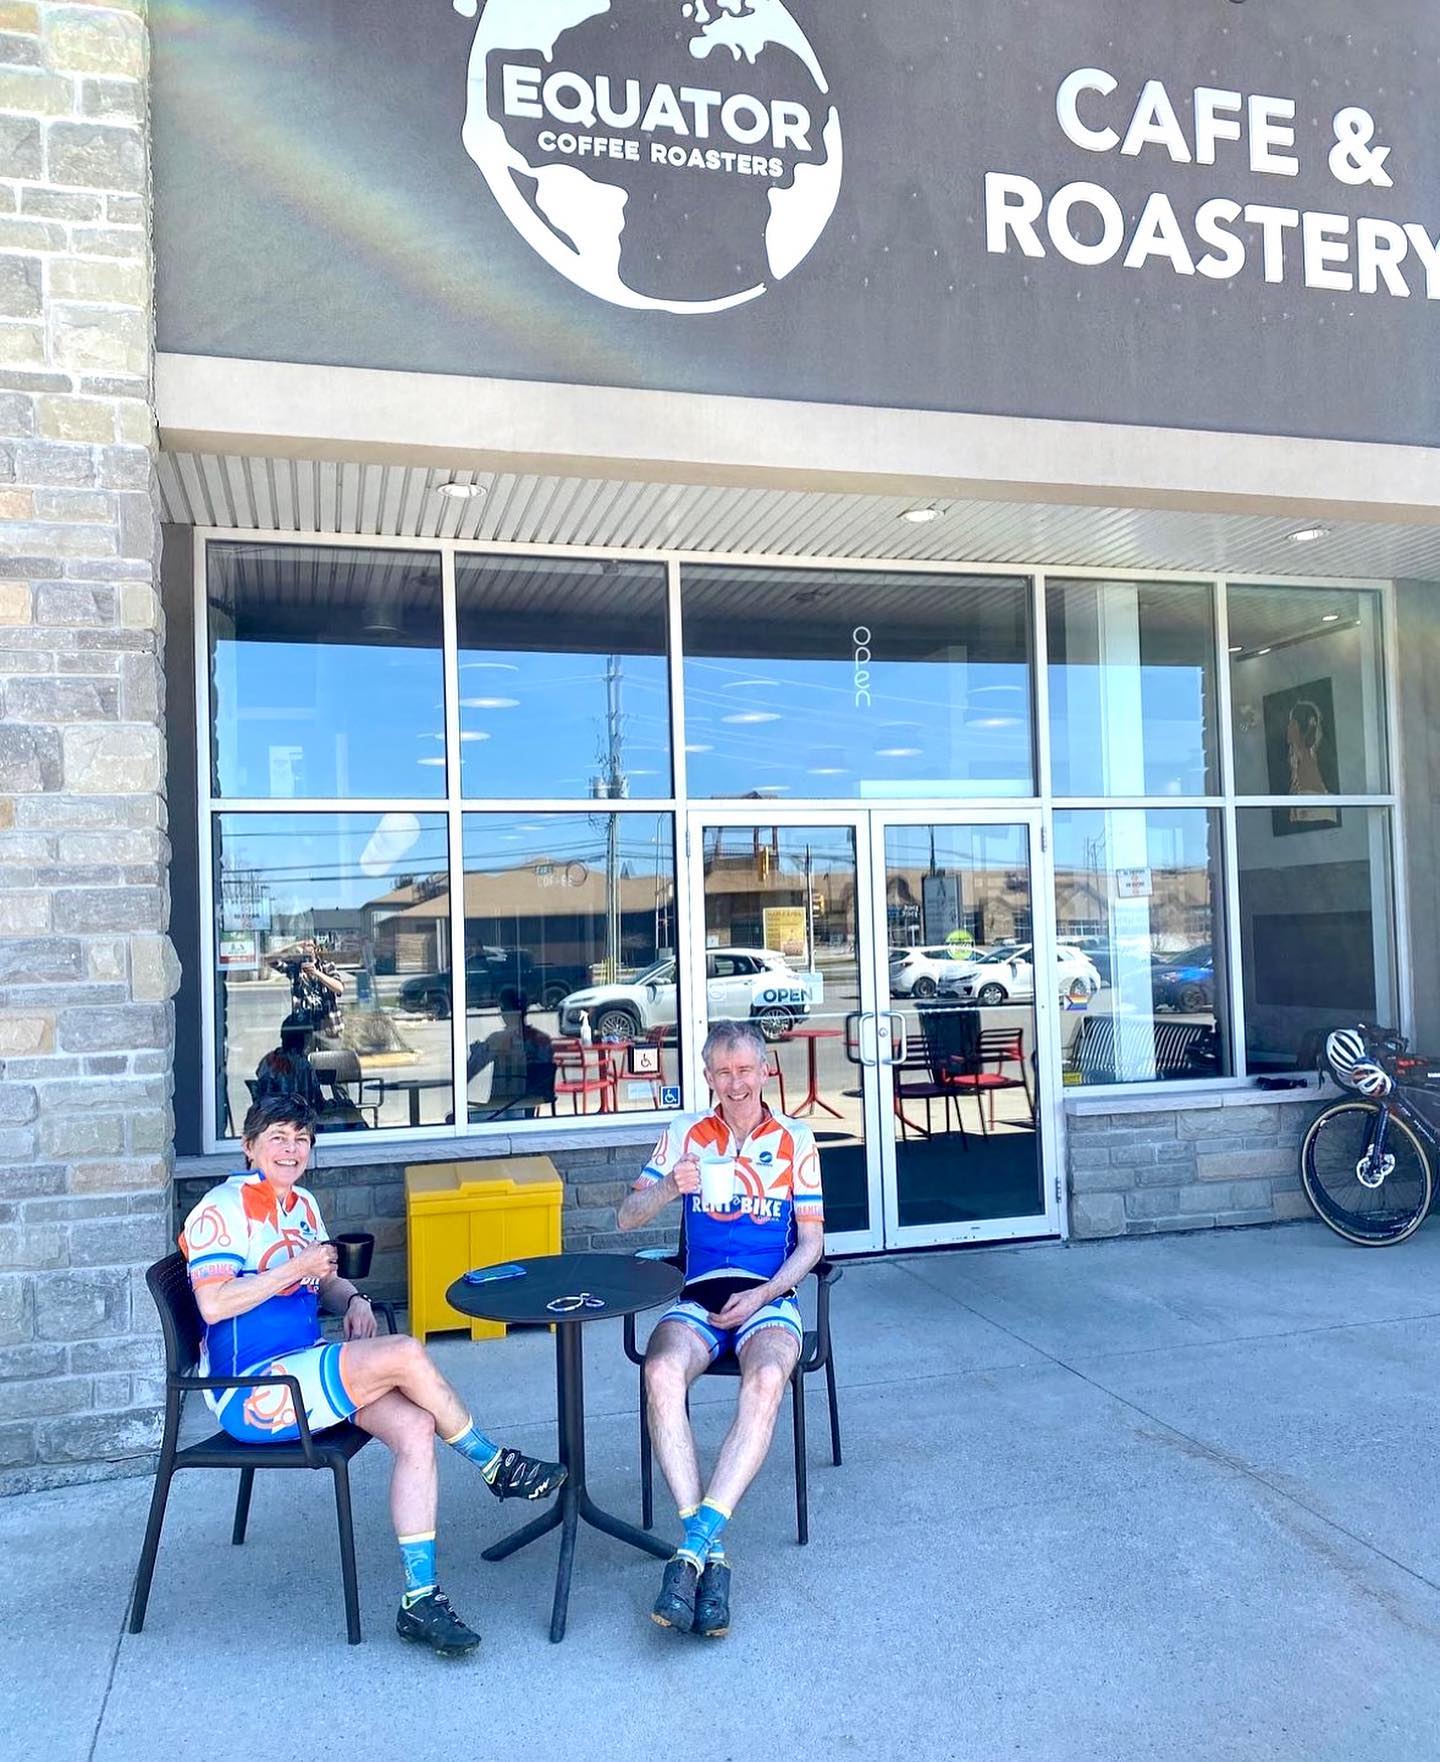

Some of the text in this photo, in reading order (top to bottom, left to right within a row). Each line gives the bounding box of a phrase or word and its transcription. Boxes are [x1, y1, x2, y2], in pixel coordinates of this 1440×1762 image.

[502, 63, 812, 151] EQUATOR
[1056, 67, 1394, 187] CAFE &
[537, 130, 784, 178] COFFEE ROASTERS
[984, 171, 1440, 300] ROASTERY
[853, 626, 871, 707] open
[763, 987, 812, 1003] OPEN
[741, 1196, 782, 1217] BIKE
